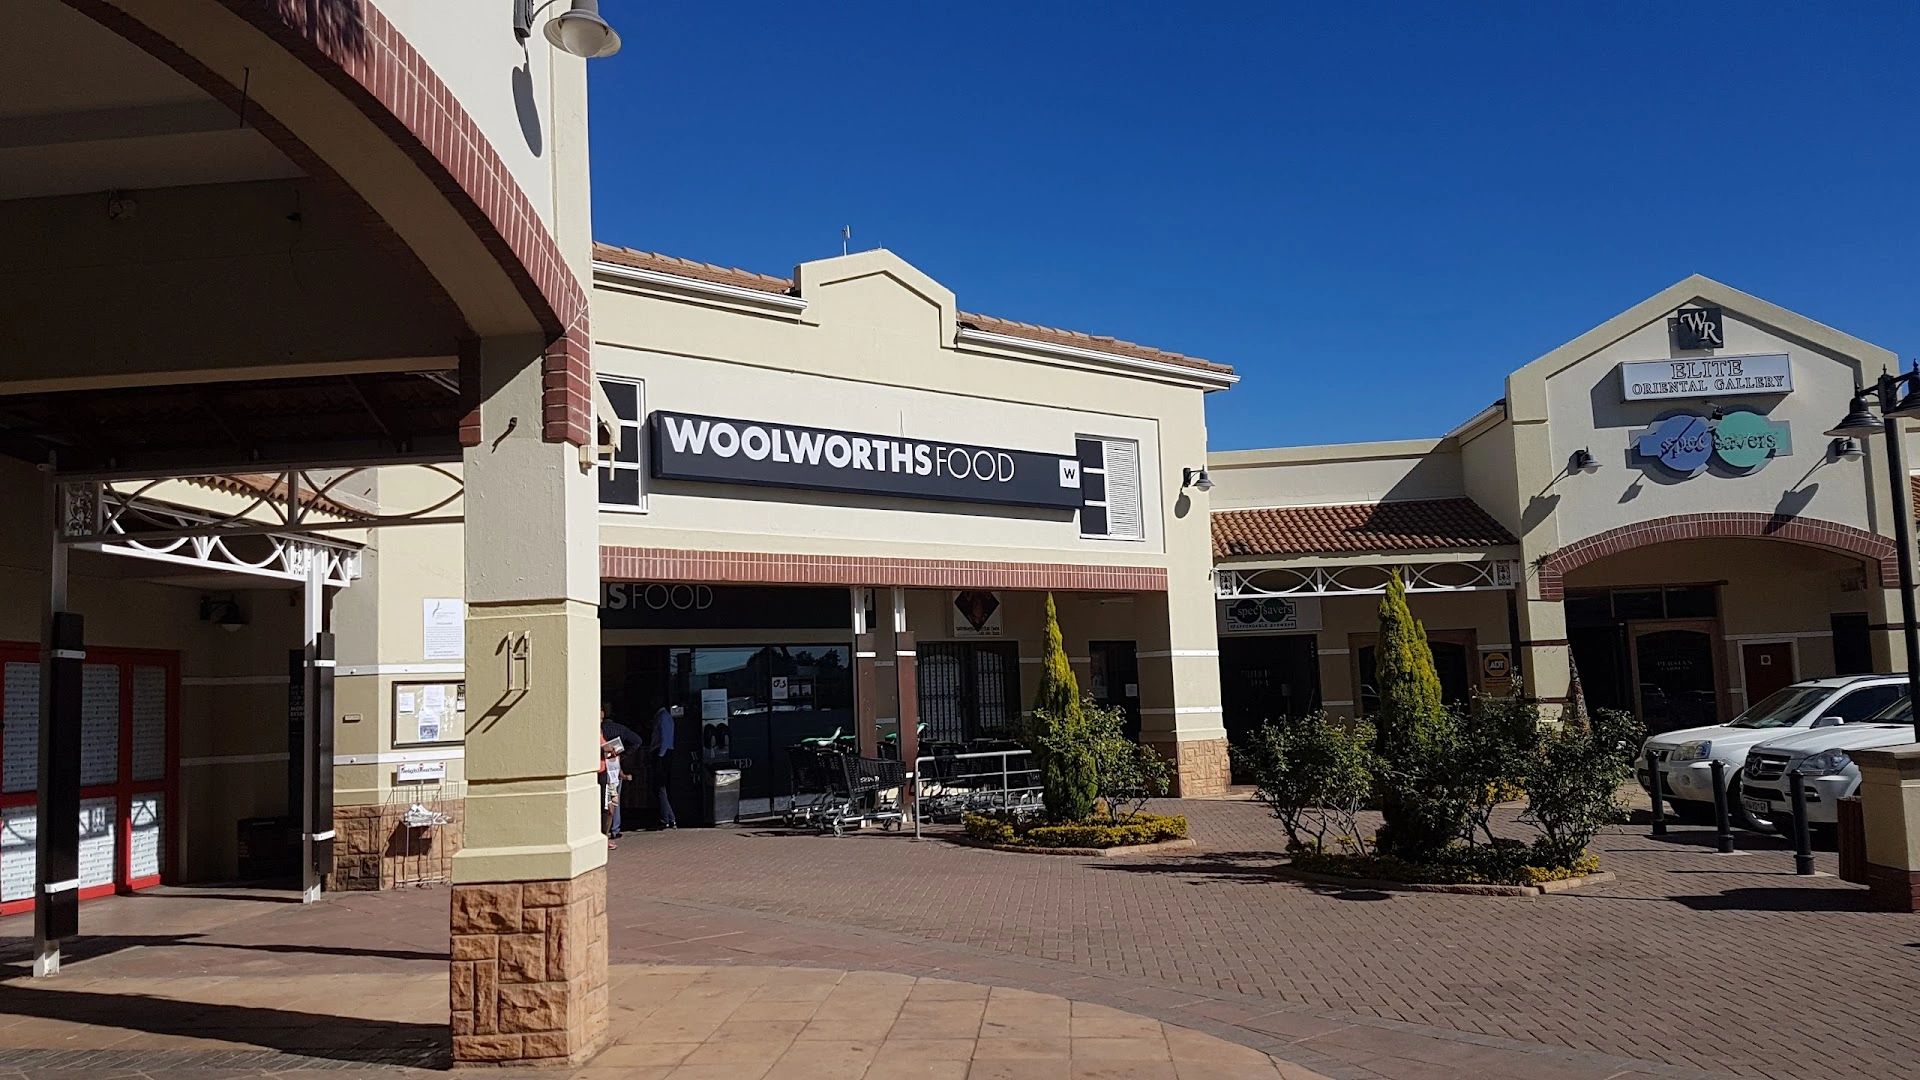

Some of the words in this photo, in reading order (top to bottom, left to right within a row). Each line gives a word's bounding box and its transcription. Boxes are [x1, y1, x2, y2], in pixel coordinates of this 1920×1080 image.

[1680, 310, 1722, 344] WR
[1671, 359, 1743, 380] ELITE
[1632, 379, 1708, 395] ORIENTAL
[1714, 375, 1784, 391] GALLERY
[663, 416, 932, 477] WOOLWORTHS
[936, 445, 1015, 483] FOOD
[1063, 466, 1077, 480] W
[632, 583, 713, 610] FOOD
[1489, 660, 1504, 669] ADT
